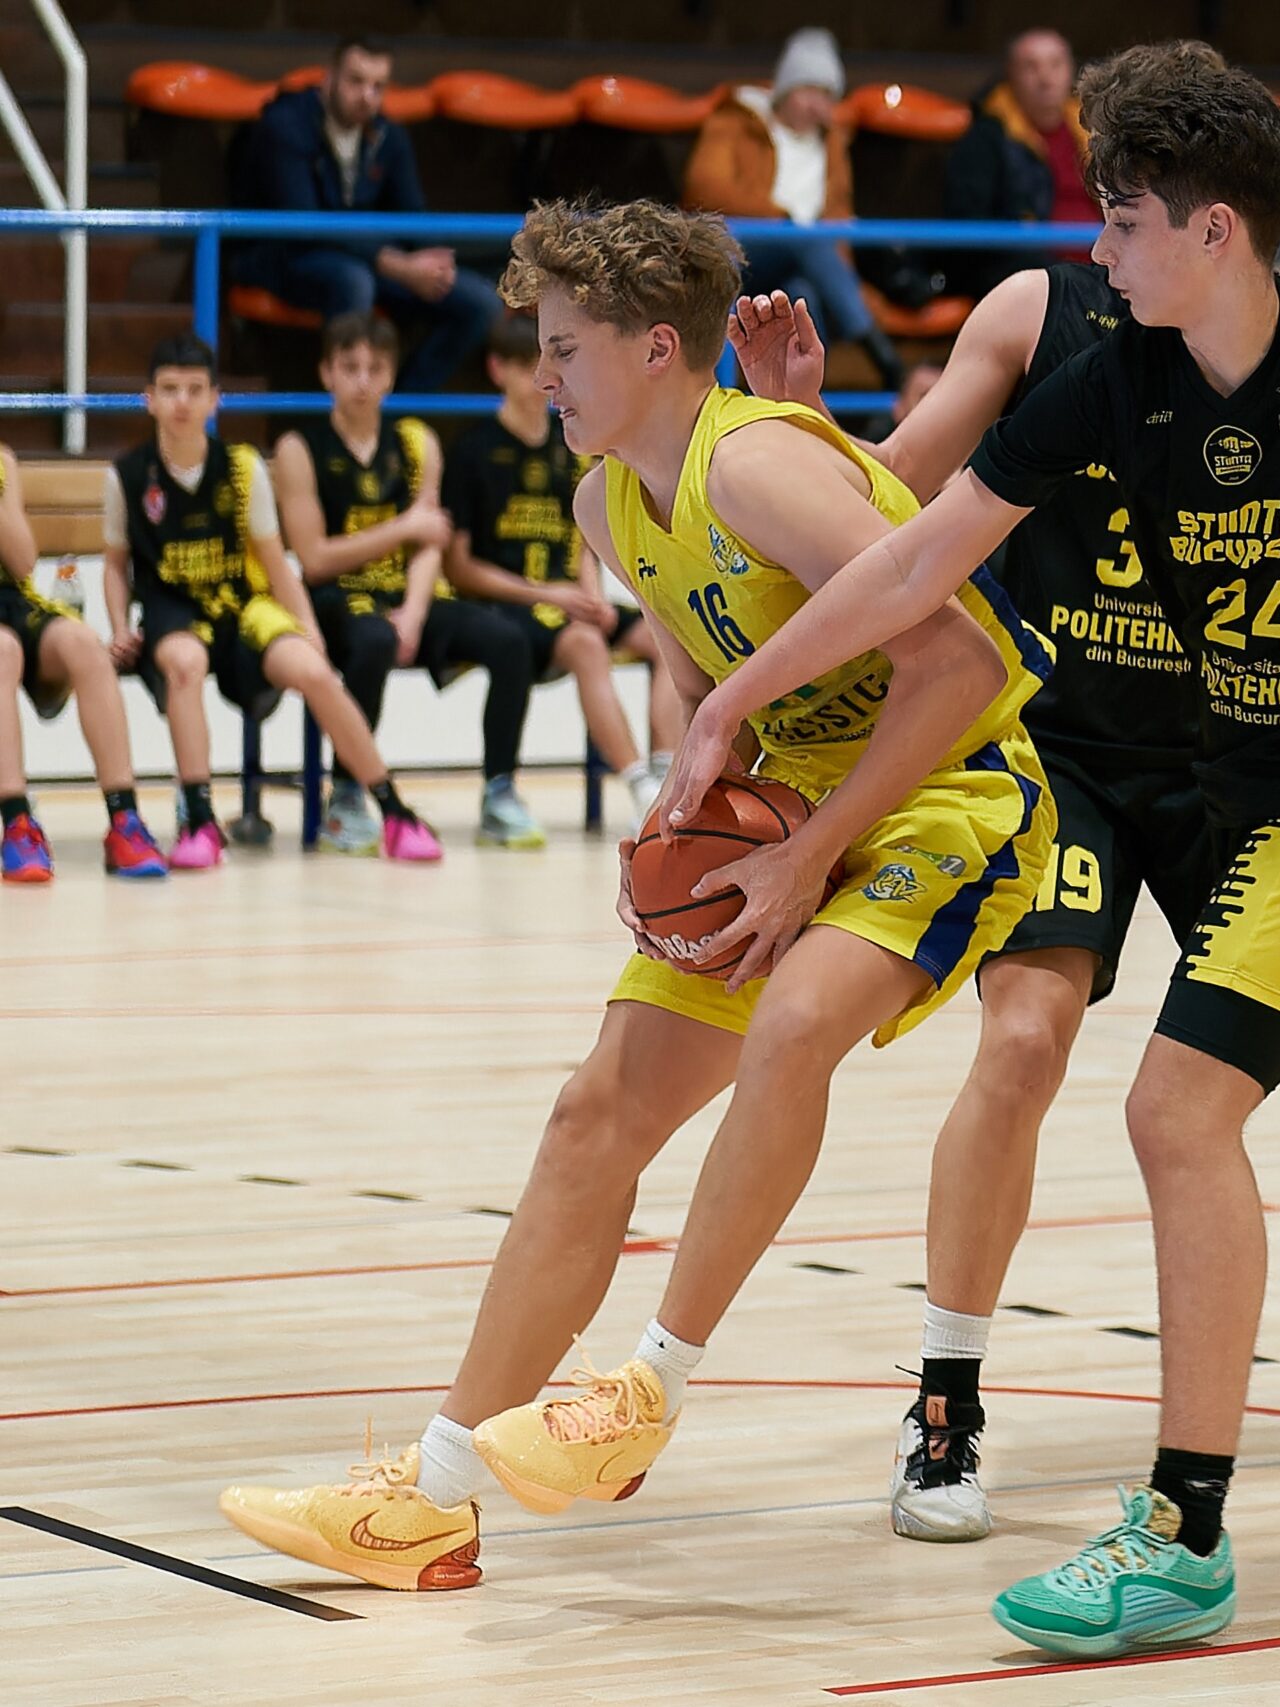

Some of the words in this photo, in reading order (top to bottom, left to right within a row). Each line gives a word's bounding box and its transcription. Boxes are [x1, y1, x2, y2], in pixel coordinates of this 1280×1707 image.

[687, 582, 756, 664] 16
[1086, 645, 1112, 663] din
[1210, 700, 1232, 718] din
